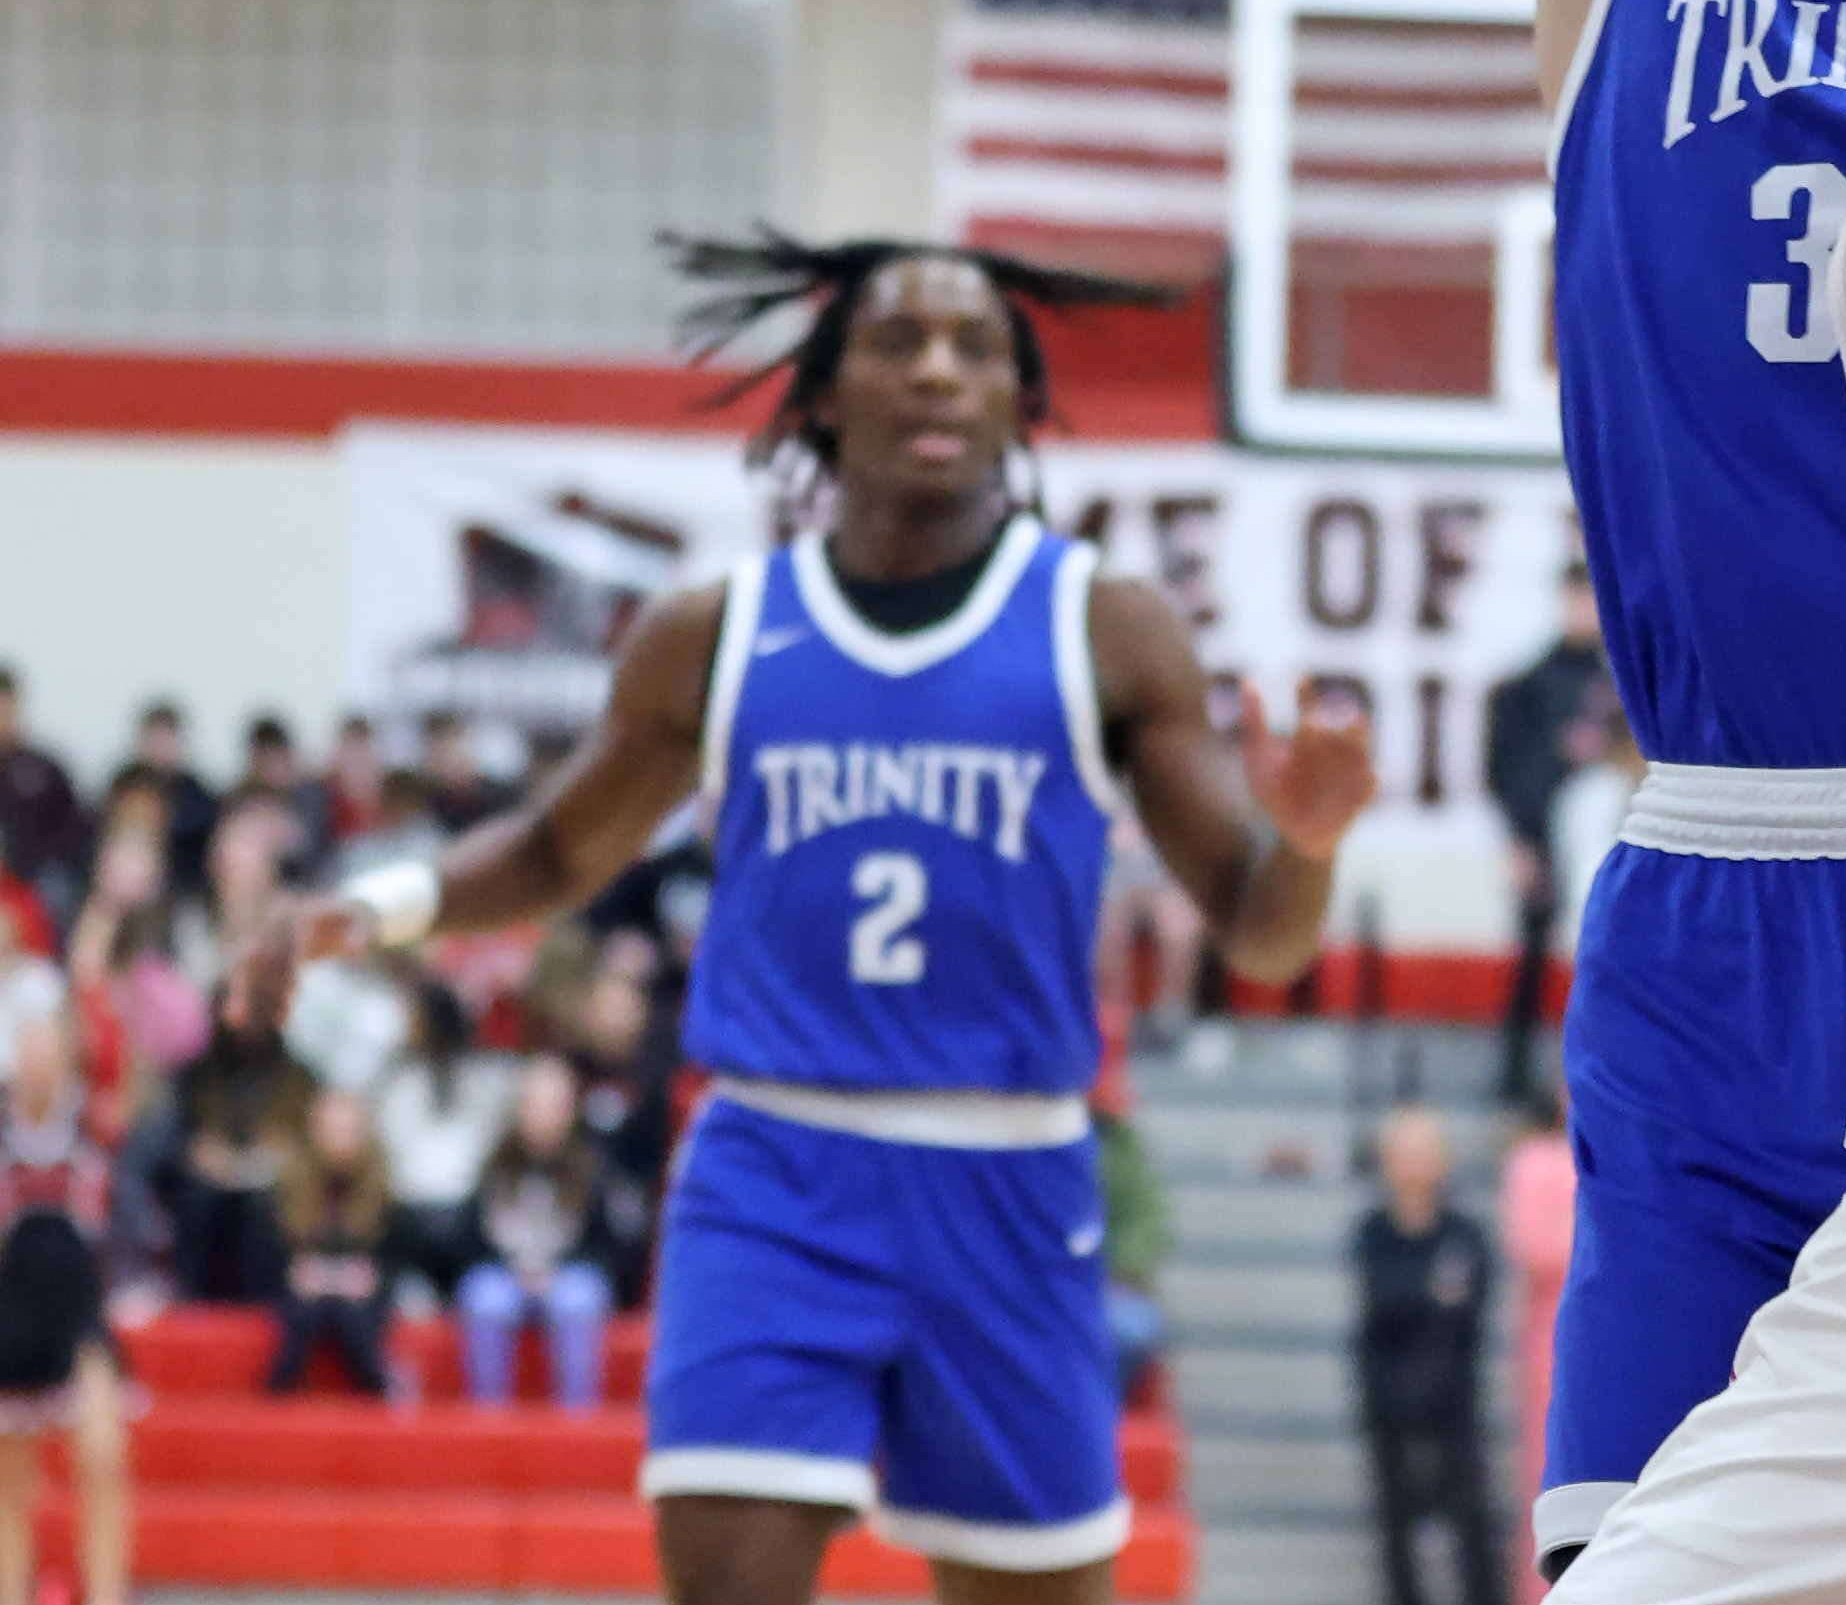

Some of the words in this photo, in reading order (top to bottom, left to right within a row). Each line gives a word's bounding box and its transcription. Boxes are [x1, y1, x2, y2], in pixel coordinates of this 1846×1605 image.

[1306, 498, 1487, 630] OF
[754, 744, 1046, 864] TRINITY
[849, 850, 928, 986] 2
